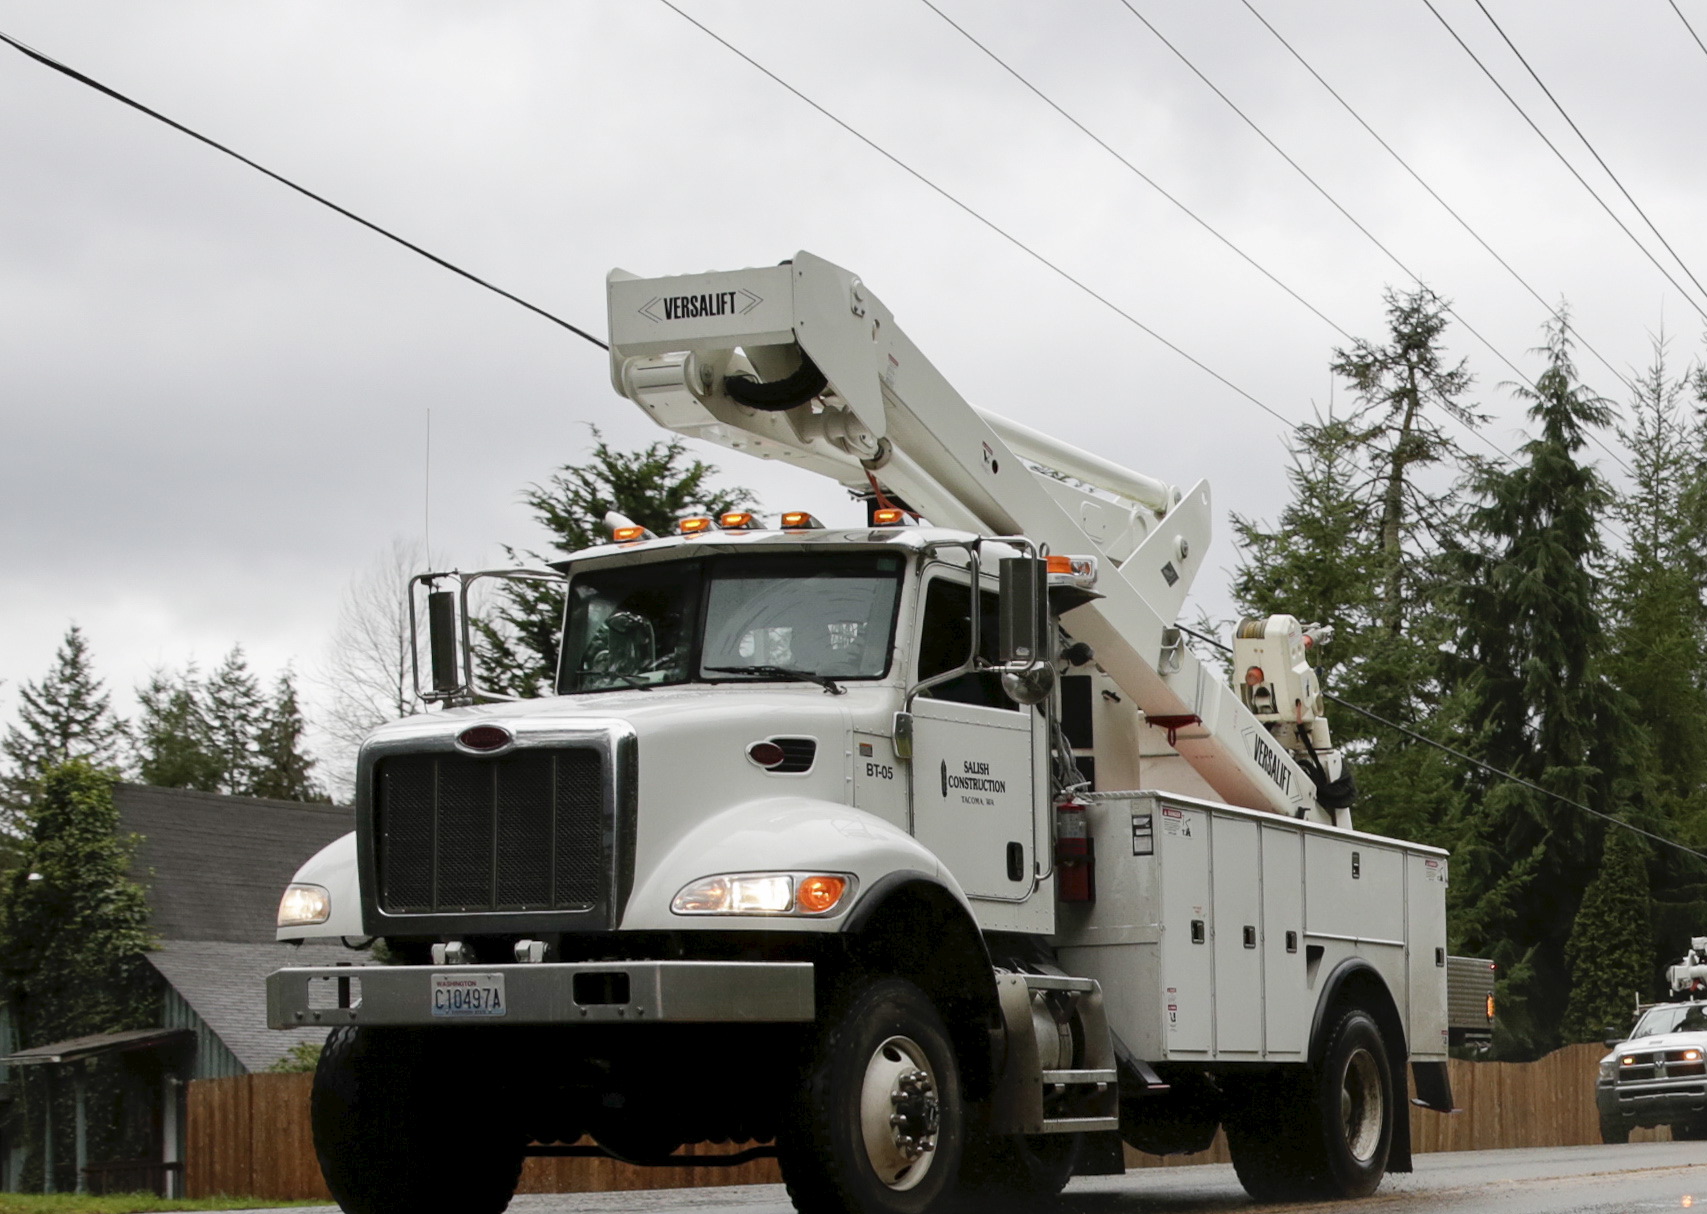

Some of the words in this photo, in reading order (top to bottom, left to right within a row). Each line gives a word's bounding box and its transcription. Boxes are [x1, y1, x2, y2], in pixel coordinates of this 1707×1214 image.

[663, 291, 737, 320] VERSALIFT
[866, 762, 894, 780] BT-05
[964, 760, 989, 775] SALISH
[1253, 733, 1292, 796] VERSALIFT
[948, 775, 1006, 793] CONSTRUCTION
[435, 988, 501, 1010] C10497A
